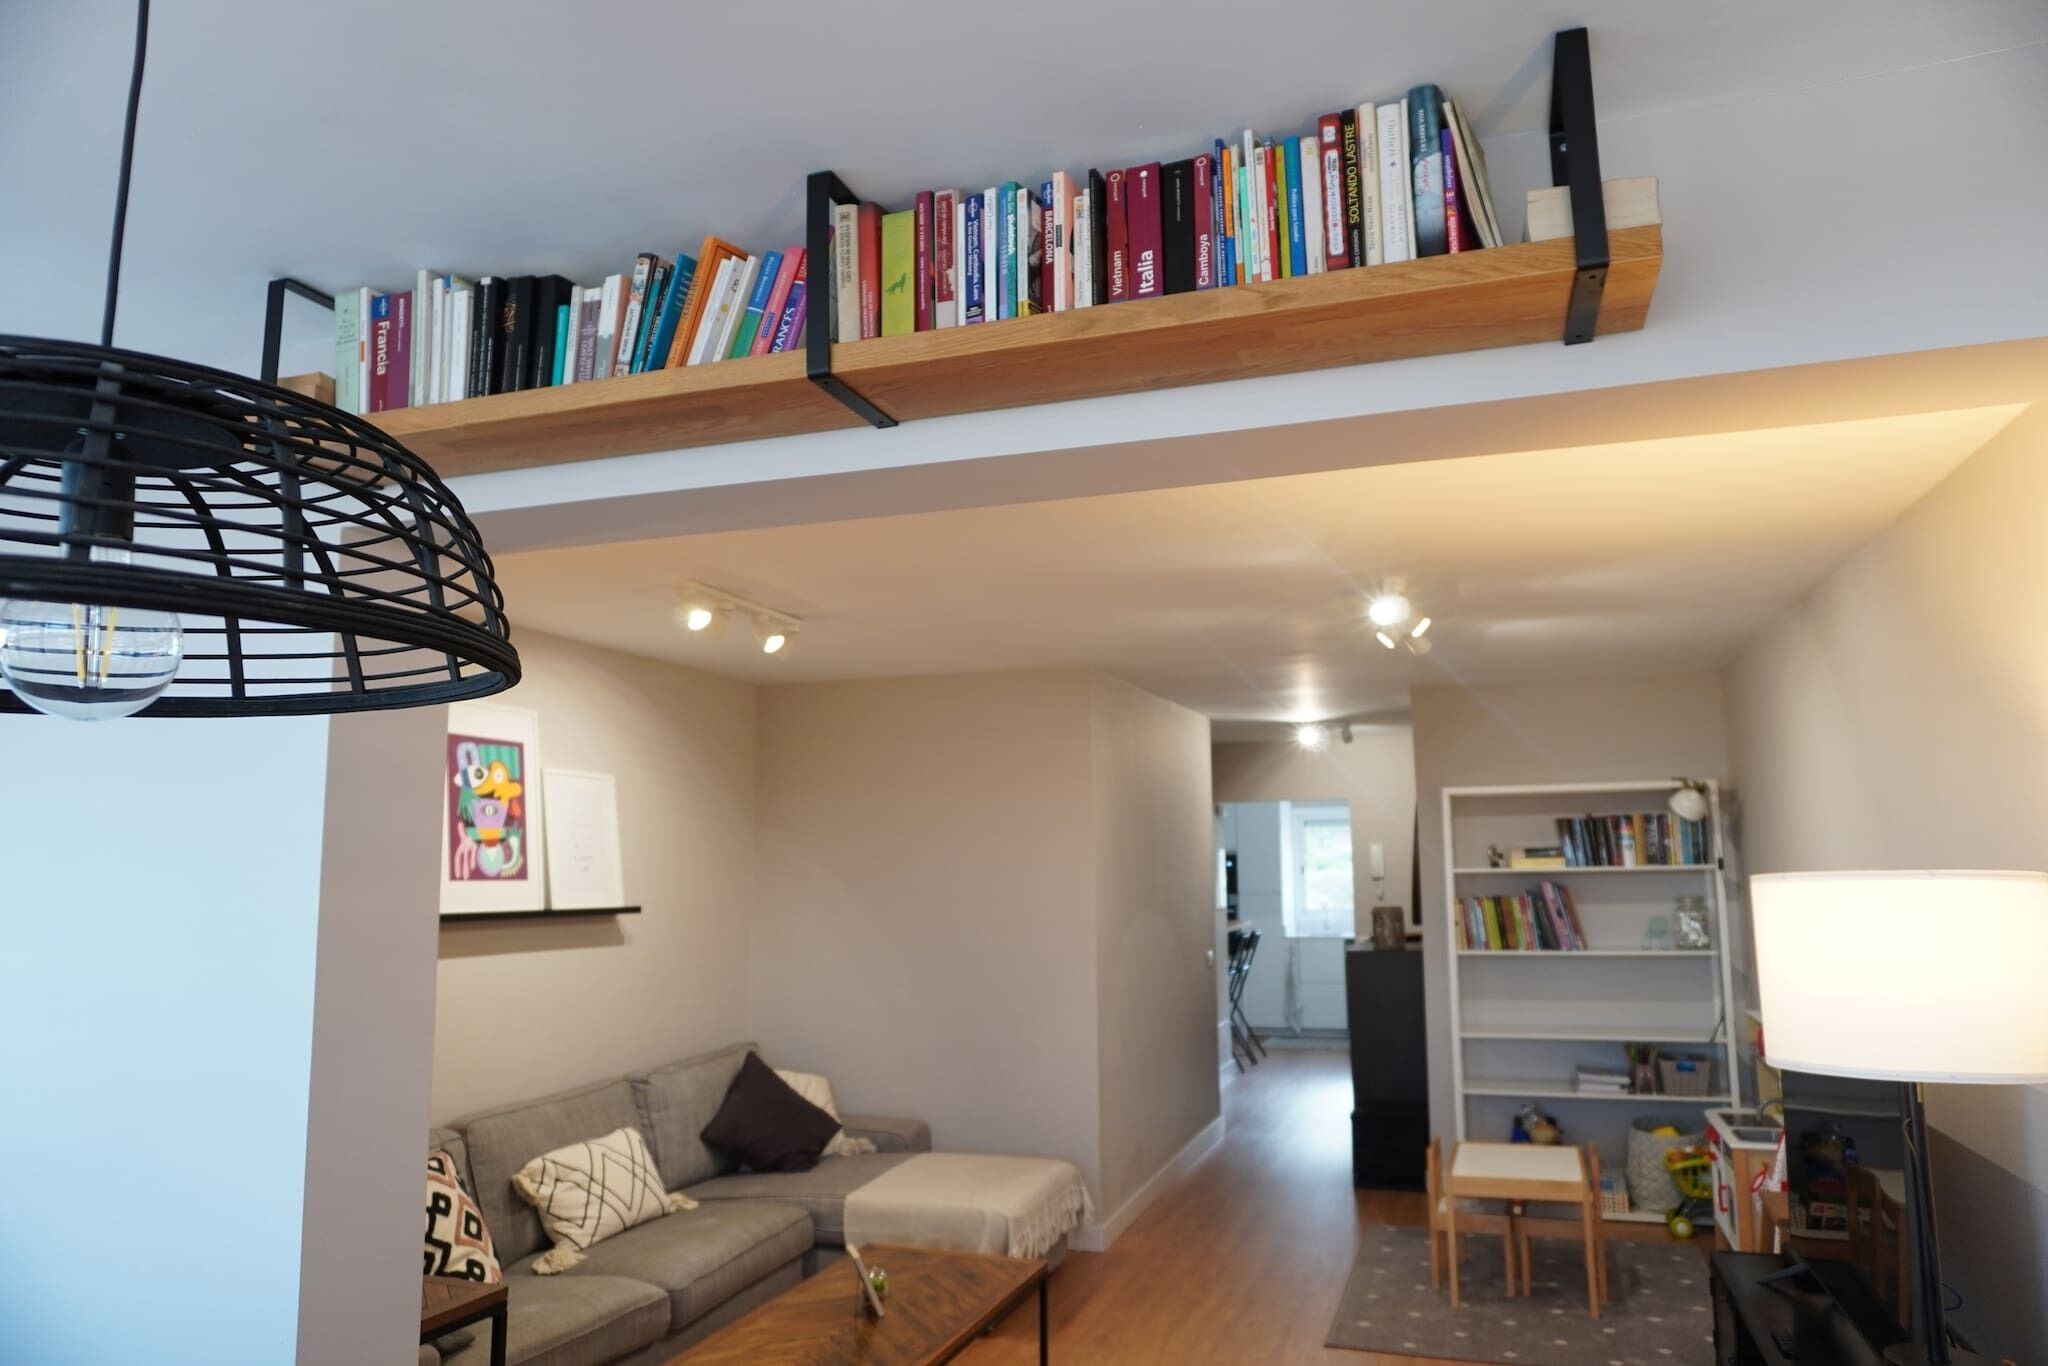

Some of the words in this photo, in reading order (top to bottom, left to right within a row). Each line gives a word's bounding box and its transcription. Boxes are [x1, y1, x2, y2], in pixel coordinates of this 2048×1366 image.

[1416, 108, 1424, 124] VIVA
[1343, 123, 1356, 163] LASTRE
[1345, 165, 1360, 224] SOLTANDO
[971, 218, 979, 248] Vietnam,
[1044, 209, 1053, 264] BARCELONA
[971, 248, 980, 283] Cambodia,
[1112, 249, 1122, 295] Vietnam
[1136, 249, 1155, 293] Italia
[1197, 233, 1209, 286] Camboya
[375, 319, 390, 375] Francia
[772, 304, 795, 355] RANCES
